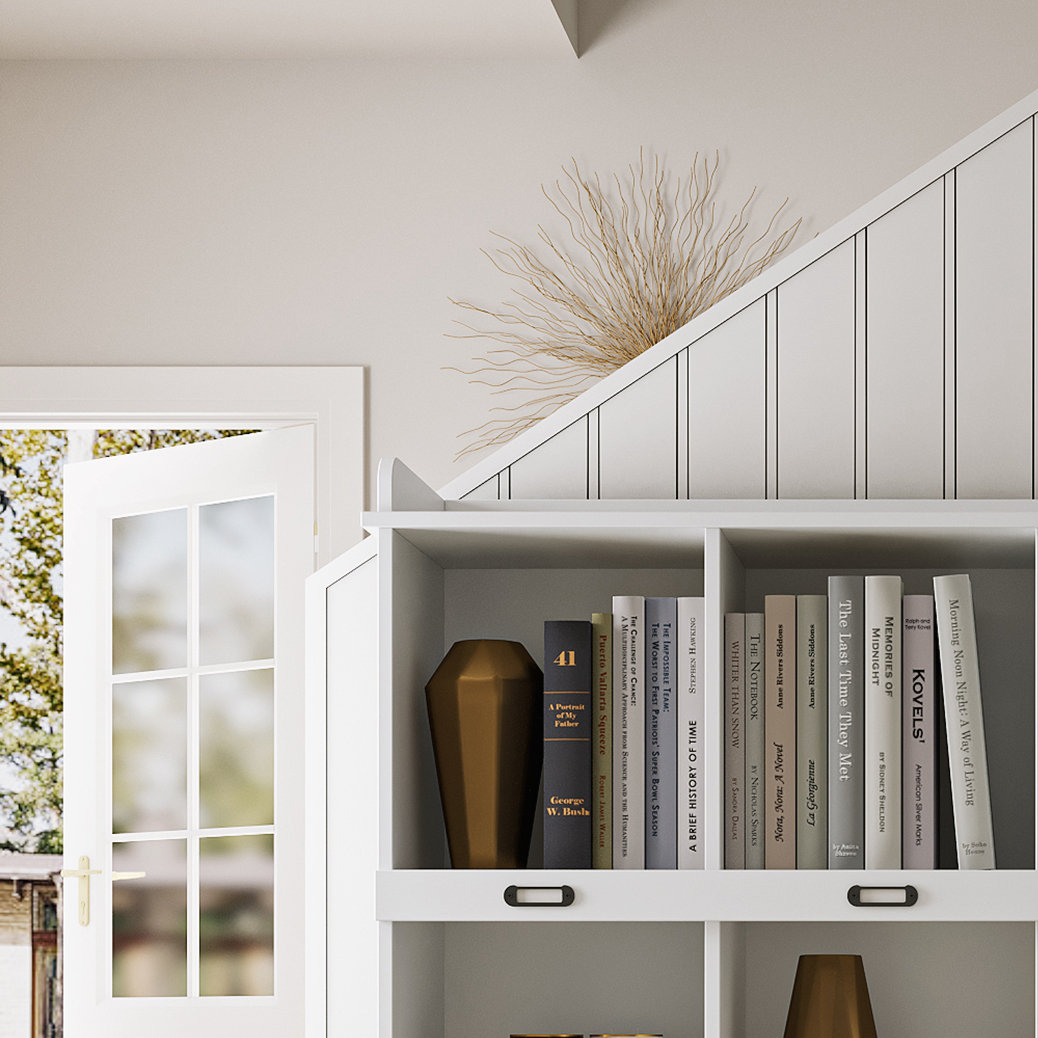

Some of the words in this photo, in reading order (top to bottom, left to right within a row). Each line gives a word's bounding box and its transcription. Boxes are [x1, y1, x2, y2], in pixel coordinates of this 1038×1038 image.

[839, 600, 852, 628] The
[949, 600, 962, 646] Morning
[554, 651, 575, 666] 41
[599, 635, 608, 669] Puerto
[839, 633, 852, 664] Last
[953, 650, 965, 677] Noon
[599, 672, 608, 711] Vallarta
[839, 671, 852, 707] Time
[955, 681, 968, 717] Night:
[555, 719, 578, 727] Father
[566, 711, 576, 720] My
[837, 712, 854, 747] They
[959, 719, 969, 728] A
[598, 715, 608, 755] Squeeze
[732, 718, 740, 748] SNOW
[960, 730, 972, 753] Way
[689, 748, 696, 761] OF
[839, 753, 854, 781] Met
[964, 756, 973, 768] of
[551, 796, 584, 805] George
[964, 771, 976, 806] Living
[563, 807, 590, 816] Bush
